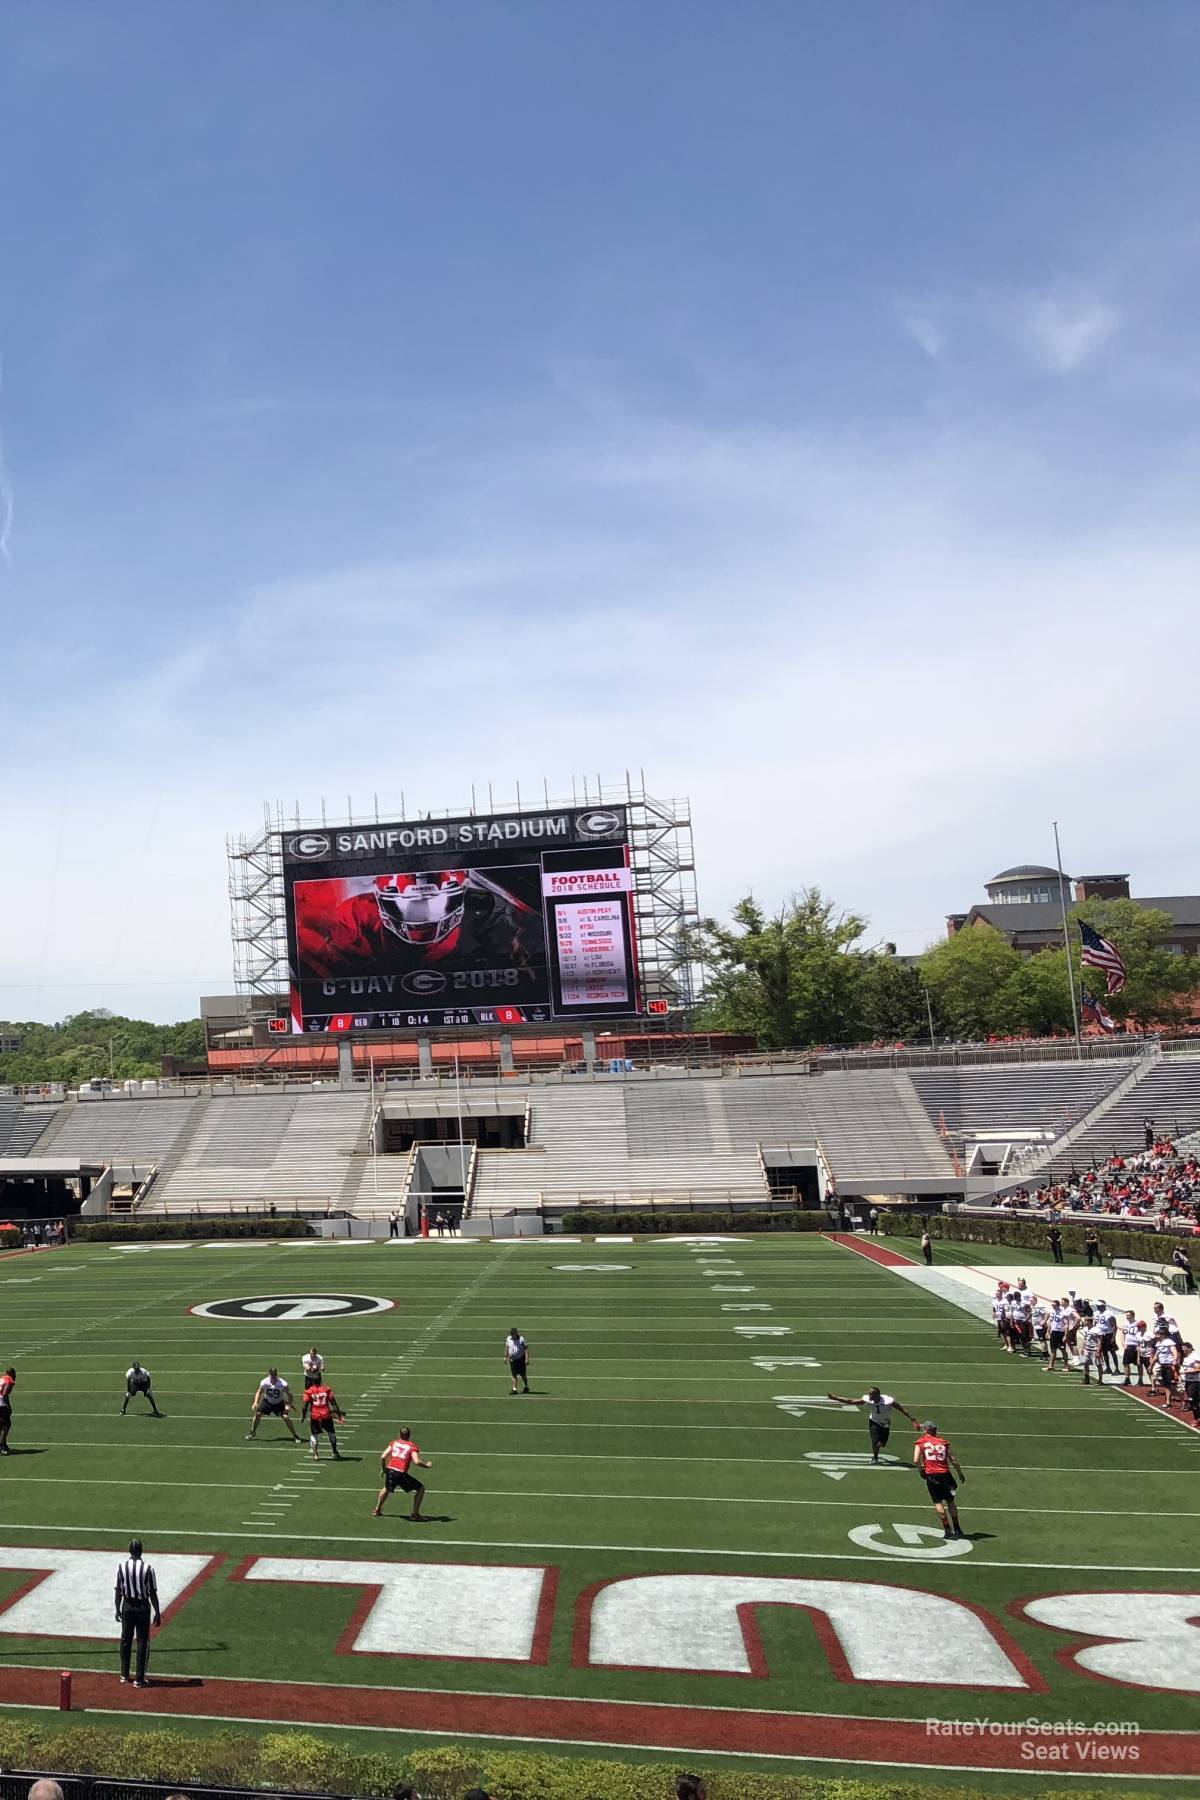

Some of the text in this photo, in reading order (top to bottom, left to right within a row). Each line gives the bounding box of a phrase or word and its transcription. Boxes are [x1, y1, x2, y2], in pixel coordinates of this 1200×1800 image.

[338, 828, 448, 852] SANFORD
[458, 818, 567, 843] STADIUM
[551, 873, 621, 885] FOOTBALL
[551, 881, 622, 893] 2018 SCHEDULE
[322, 975, 396, 996] G-DAY
[453, 968, 520, 989] 2018
[650, 1001, 666, 1012] 40
[407, 1014, 429, 1025] 0:14
[480, 1012, 494, 1021] BLK
[270, 1020, 285, 1031] 40
[354, 1018, 368, 1027] RED
[875, 1404, 881, 1414] 1
